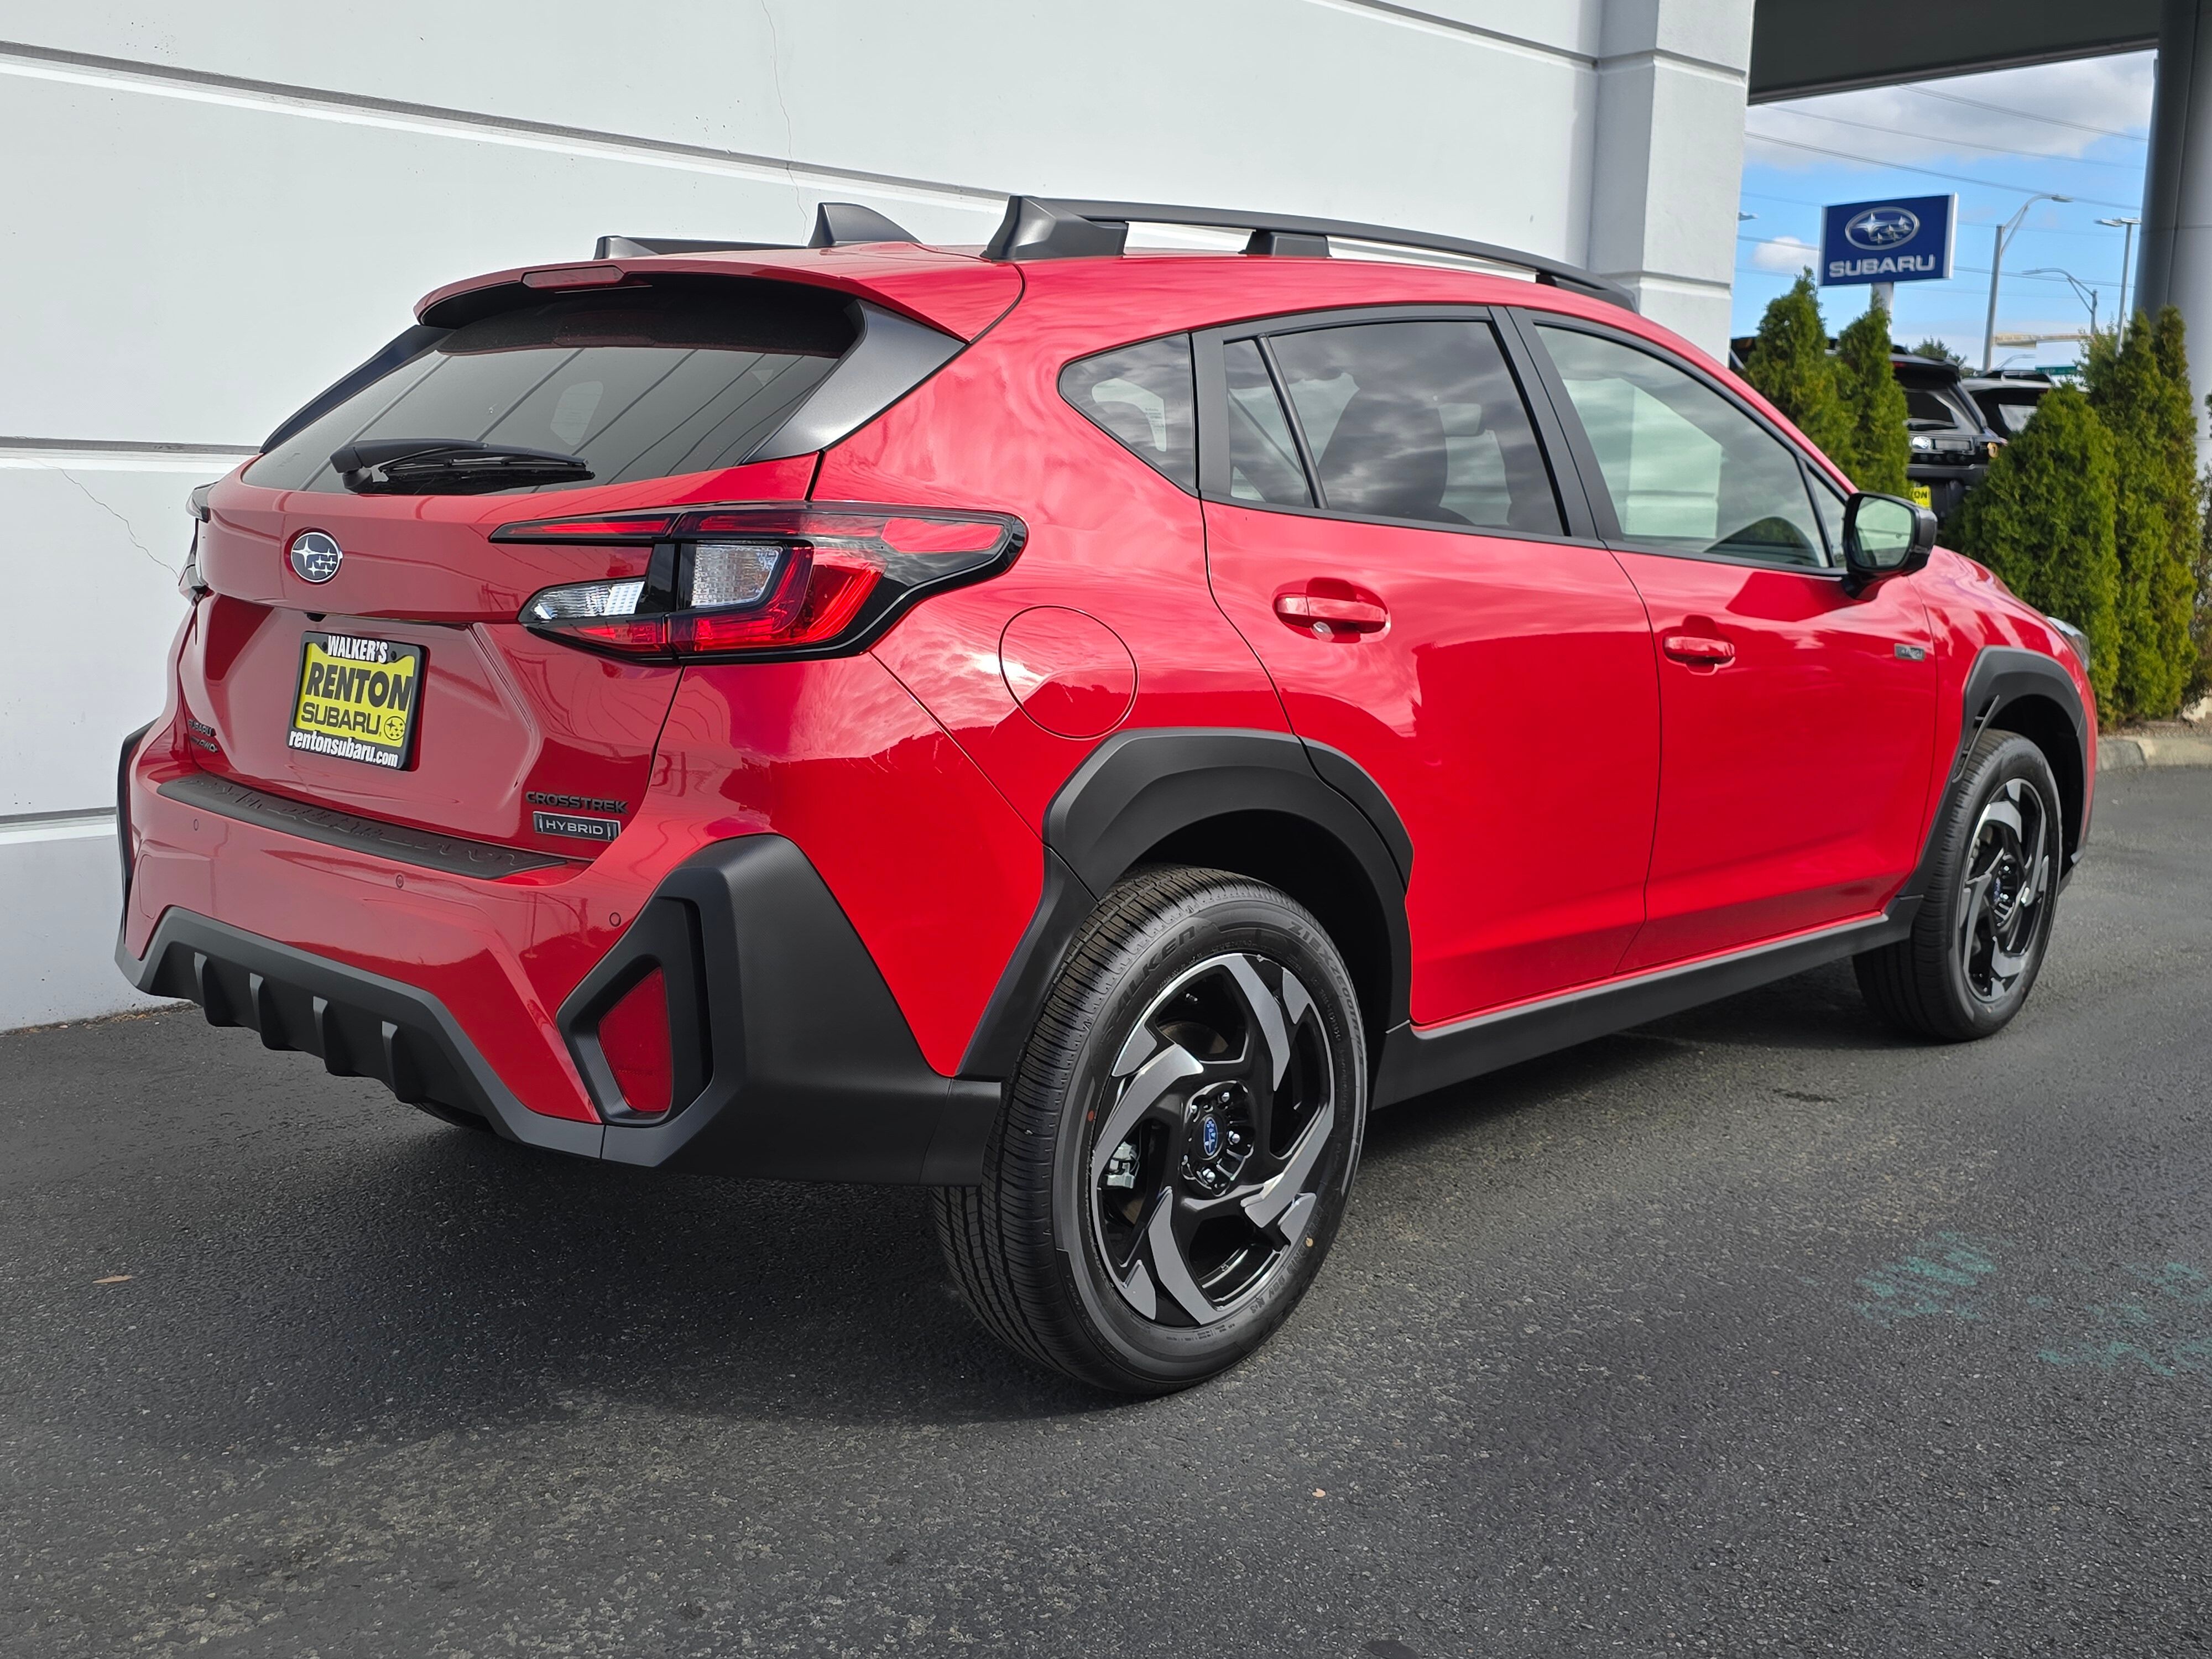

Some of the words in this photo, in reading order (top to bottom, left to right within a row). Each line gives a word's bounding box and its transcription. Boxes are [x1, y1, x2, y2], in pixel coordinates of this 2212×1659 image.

[1829, 254, 1936, 278] SUBARU
[327, 635, 388, 664] WALKER'S
[305, 662, 414, 712] RENTON
[301, 702, 381, 735] SUBARU
[289, 731, 399, 767] rentonsubaru.com
[525, 791, 629, 815] CROSSTREK
[546, 819, 604, 835] HYBRID
[1288, 921, 1334, 964] ZIEX
[1100, 926, 1196, 1043] FALKEN
